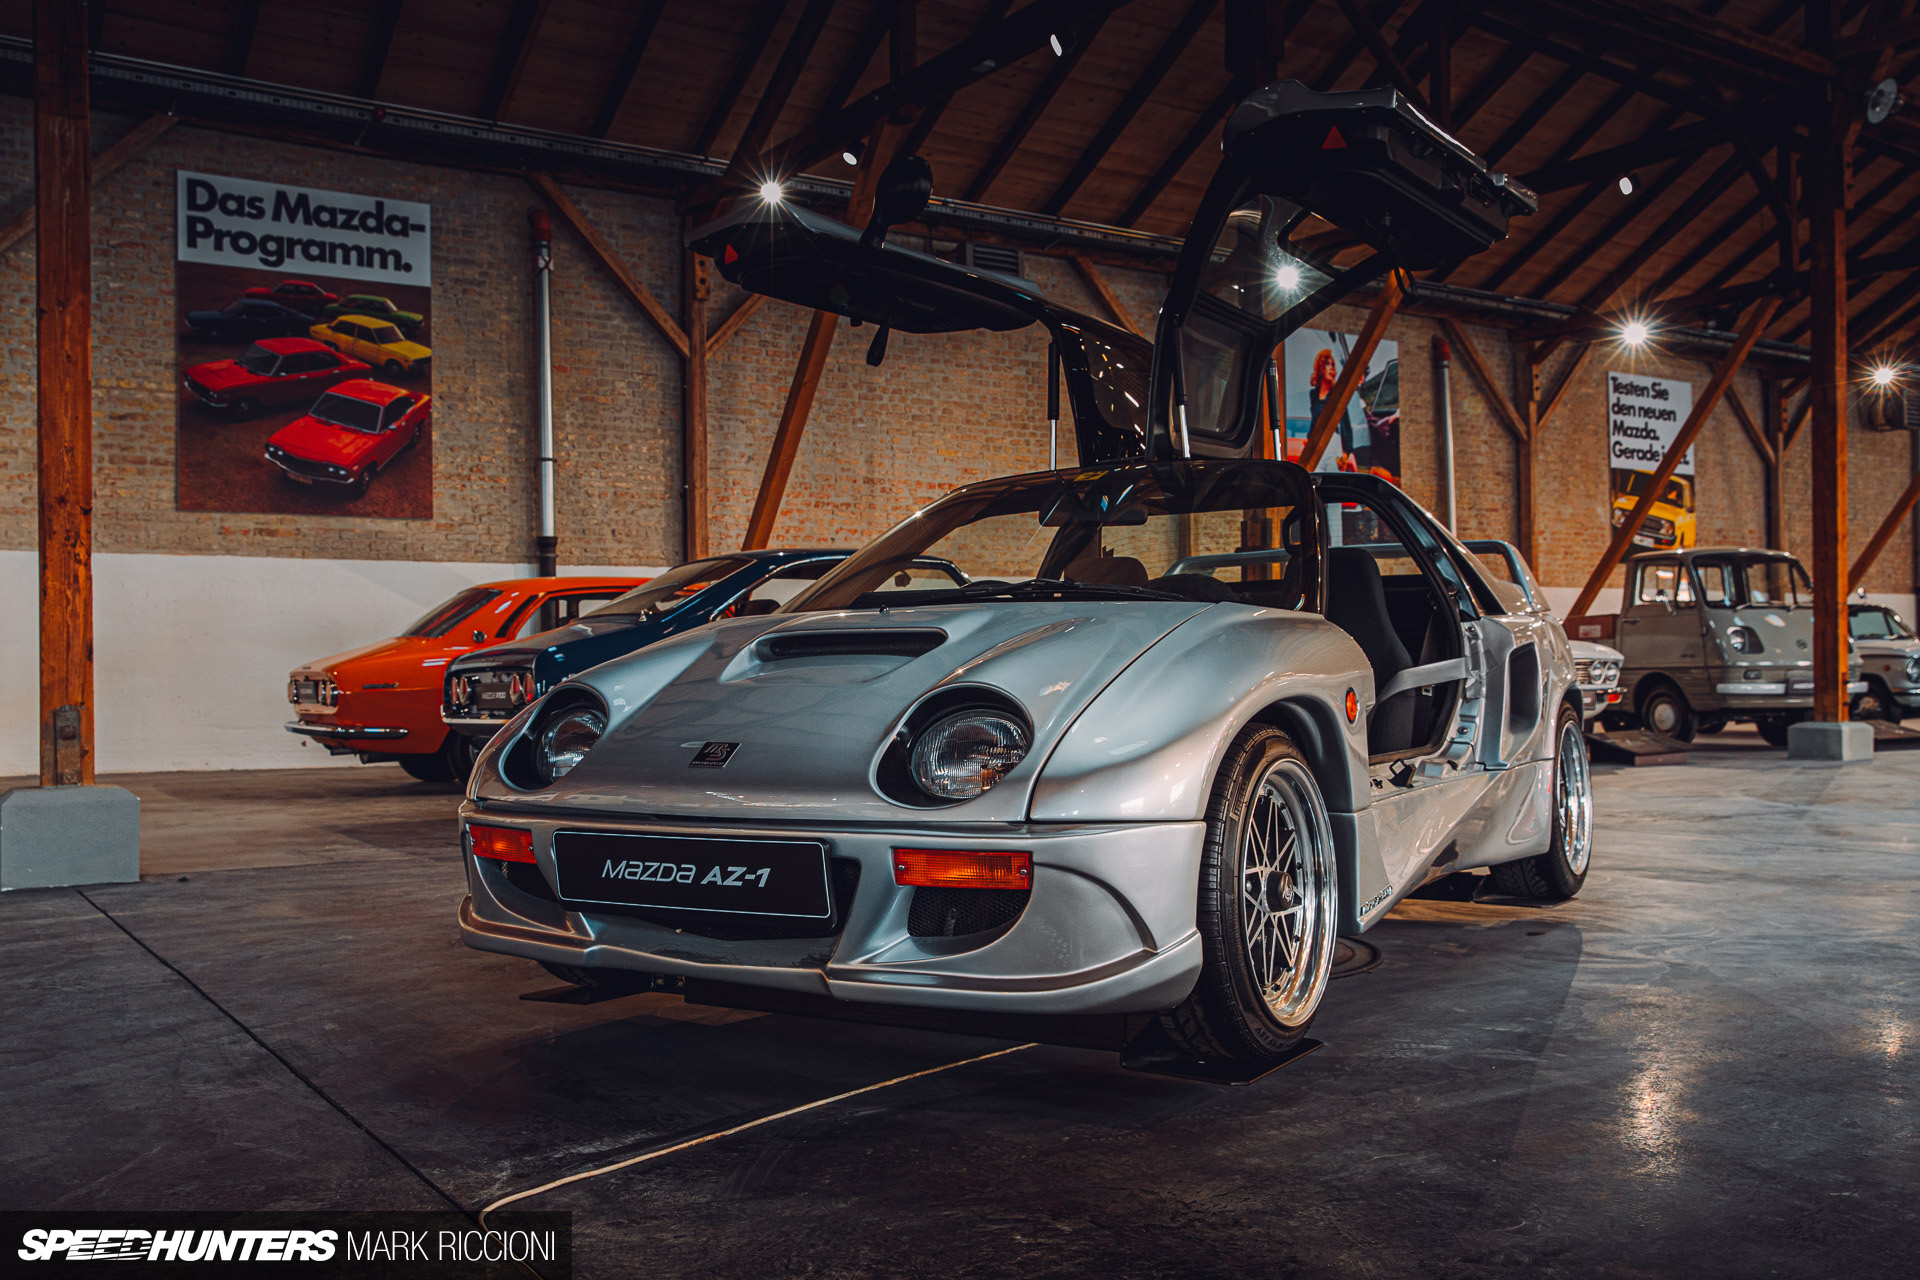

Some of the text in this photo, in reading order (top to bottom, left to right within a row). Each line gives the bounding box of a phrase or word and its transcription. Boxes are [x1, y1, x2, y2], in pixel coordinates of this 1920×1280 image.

[186, 178, 427, 238] Das Mazda-
[186, 215, 413, 273] Programm.
[1611, 376, 1670, 401] Testen Sie
[1611, 397, 1677, 422] den neuen
[1612, 419, 1660, 441] Mazda.
[1612, 441, 1660, 462] Gerade
[700, 865, 771, 888] AZ-1
